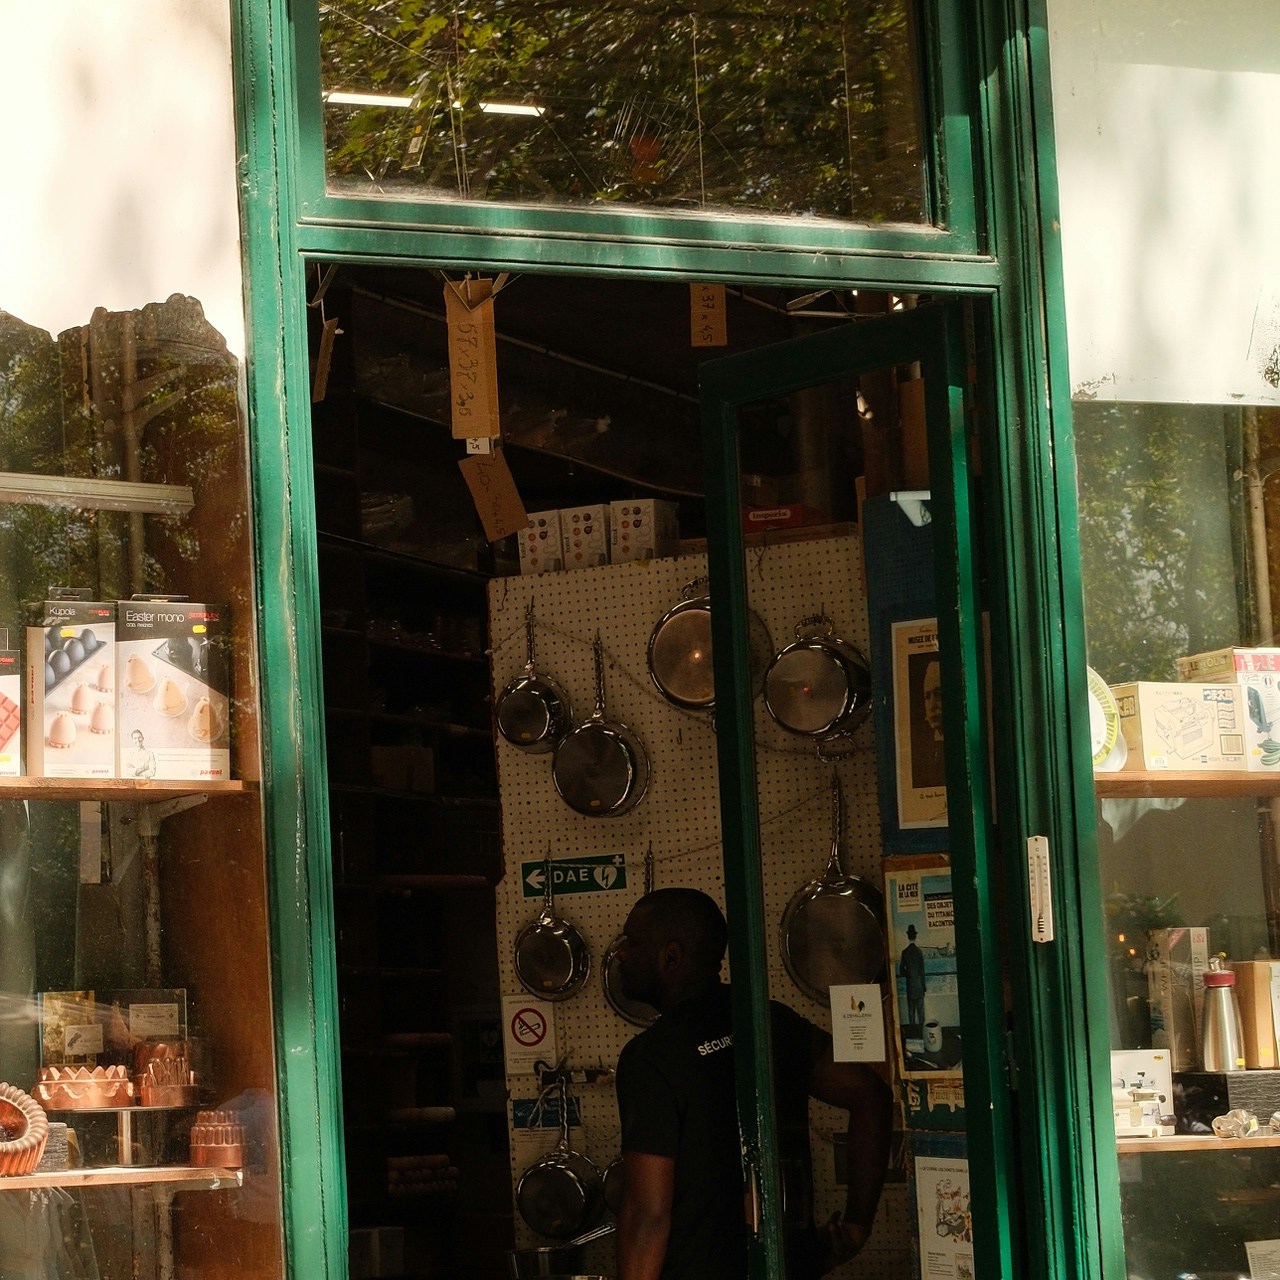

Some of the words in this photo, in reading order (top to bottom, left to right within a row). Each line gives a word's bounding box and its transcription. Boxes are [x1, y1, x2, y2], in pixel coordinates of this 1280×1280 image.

[49, 606, 76, 617] Kupola
[126, 610, 154, 622] Easter
[157, 613, 185, 623] mono
[553, 869, 589, 883] DAE
[1194, 956, 1203, 991] WHIP
[697, 1033, 734, 1056] SÉCUR
